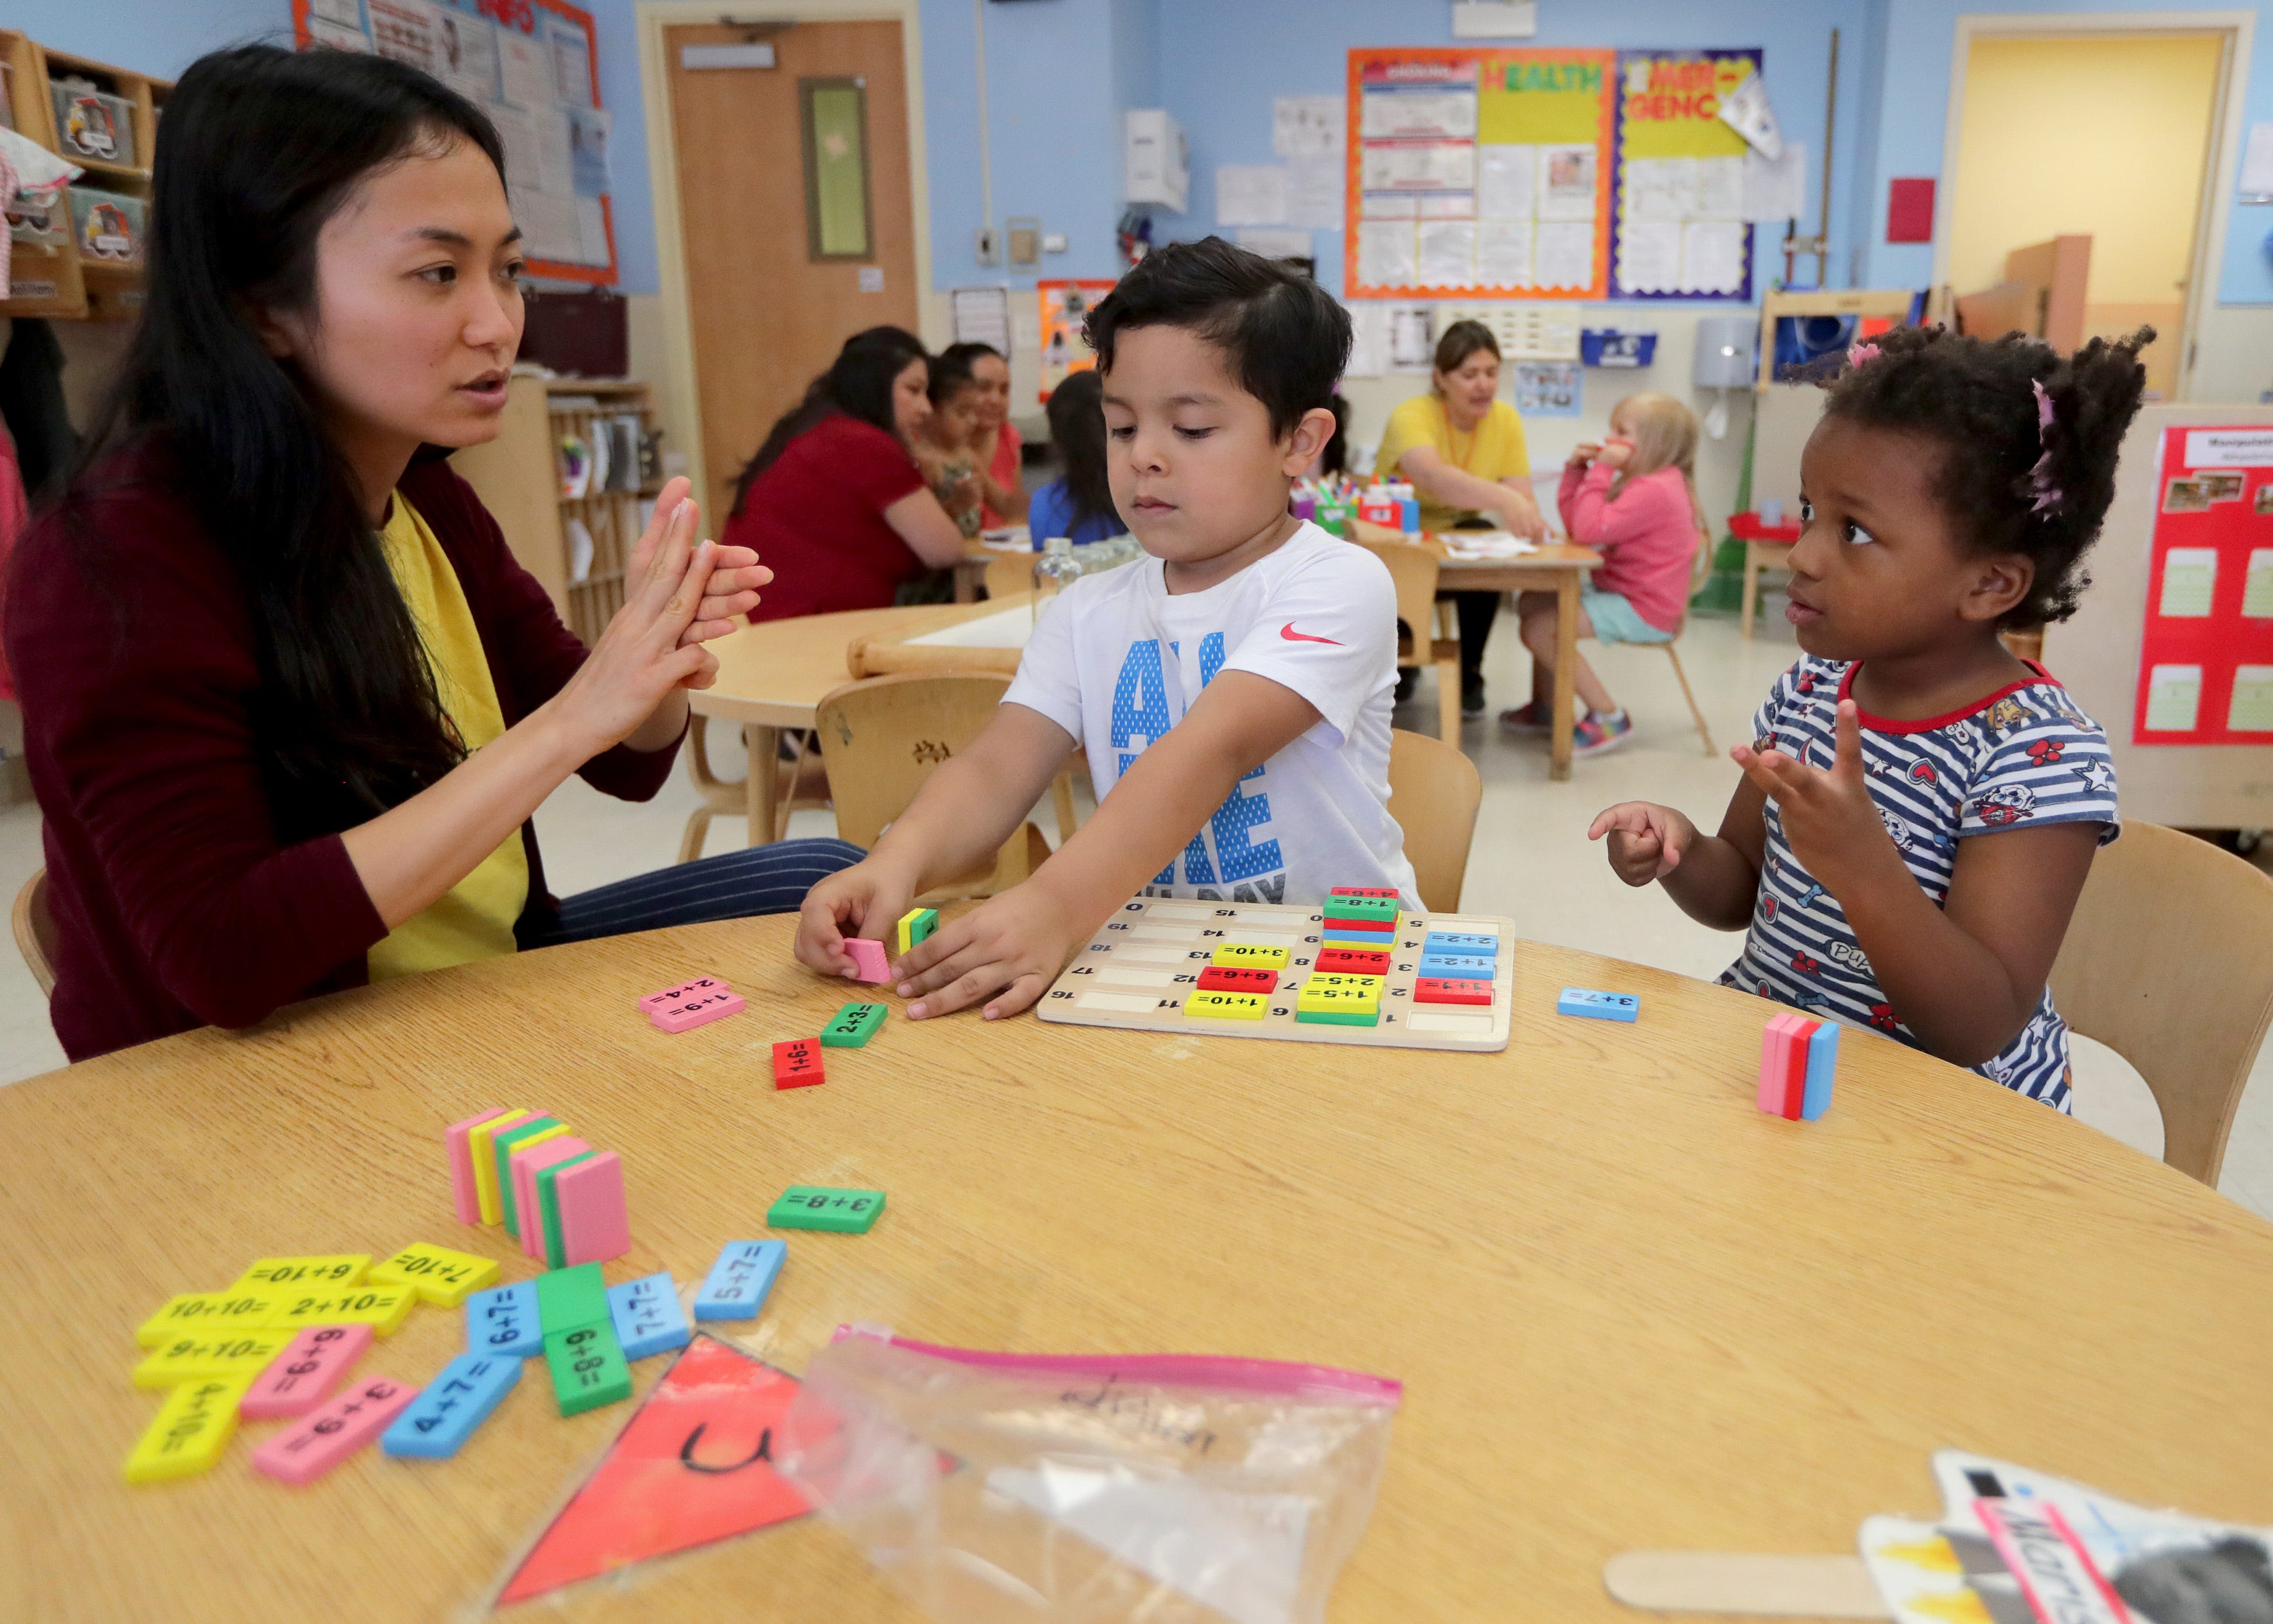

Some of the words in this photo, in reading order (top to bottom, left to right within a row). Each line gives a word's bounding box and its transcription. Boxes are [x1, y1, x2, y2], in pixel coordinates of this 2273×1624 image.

[1482, 63, 1602, 93] HEALTH
[1628, 93, 1727, 120] GENC
[1333, 899, 1389, 907] 1+8=
[1431, 935, 1491, 944] 2+2=
[1090, 944, 1113, 952] 18
[1223, 947, 1283, 957] 3+10=
[1188, 951, 1212, 960] 13
[1324, 952, 1384, 962] 2+6=
[1428, 957, 1488, 966] 1+2=
[1071, 967, 1095, 975] 17
[1208, 970, 1269, 980] 6+6=
[1173, 974, 1198, 983] 12
[1312, 977, 1375, 986] 2+5=
[649, 979, 715, 1003] 2+4=
[1283, 982, 1299, 991] 7
[1426, 981, 1483, 990] 1+1=
[1050, 991, 1075, 999] 16
[1306, 989, 1368, 999] 1+5=
[1391, 988, 1408, 996] 2
[669, 994, 729, 1016] 1+9=
[1157, 999, 1181, 1009] 11
[1198, 996, 1258, 1006] 1+10=
[1569, 992, 1632, 1006] 3+7=
[1272, 1007, 1289, 1016] 6
[836, 1003, 872, 1034] 2+3=
[1385, 1014, 1398, 1023] 1
[787, 1042, 811, 1071] 1+6=
[787, 1194, 872, 1213] 3+8=
[251, 1263, 353, 1283] 6+10=
[395, 1253, 472, 1283] 7+10=
[715, 1245, 762, 1300] 5+7=
[170, 1297, 270, 1317] 10+10=
[290, 1294, 399, 1315] 2+10=
[628, 1282, 666, 1336] 7+7=
[488, 1289, 520, 1345] 6+7=
[167, 1339, 275, 1358] 9+10=
[274, 1328, 347, 1394] 6+9=
[565, 1329, 604, 1387] 6+8=
[414, 1360, 491, 1433] 4+7=
[284, 1383, 397, 1452] 3+9=
